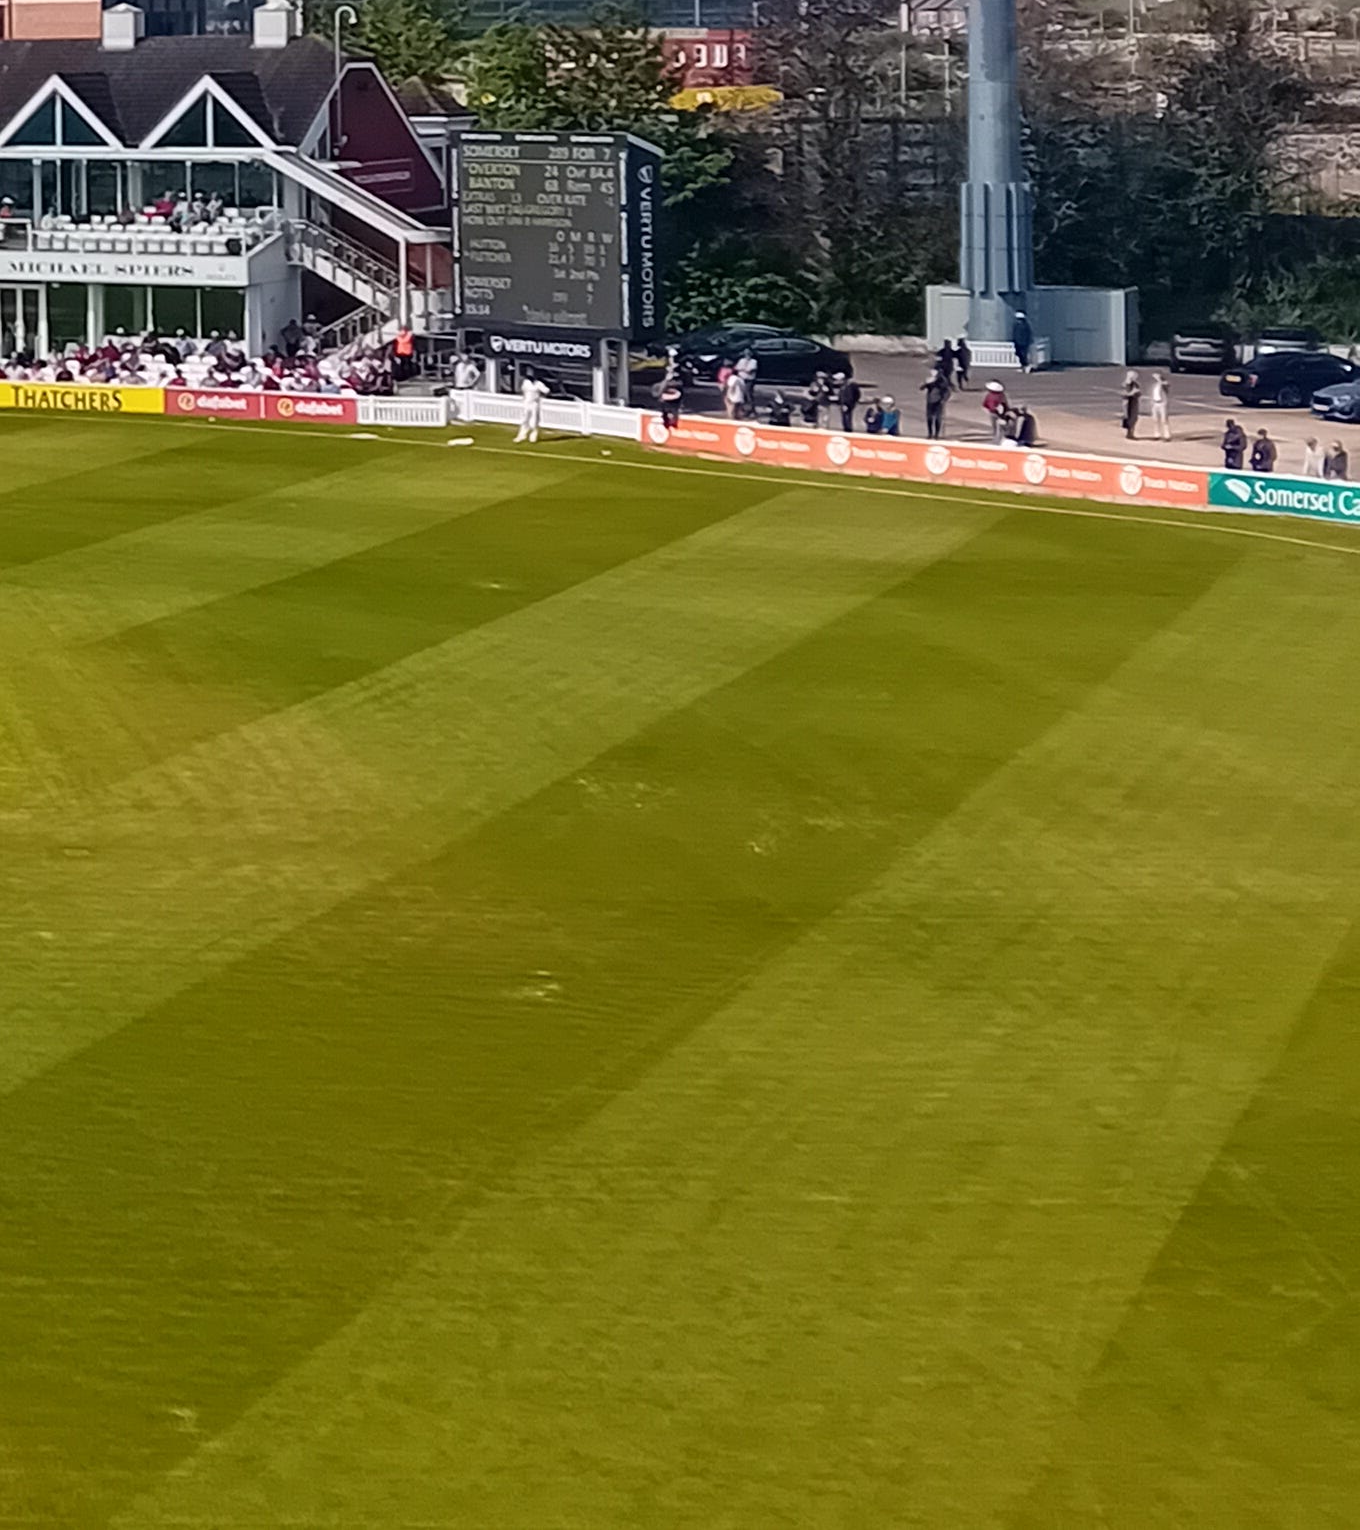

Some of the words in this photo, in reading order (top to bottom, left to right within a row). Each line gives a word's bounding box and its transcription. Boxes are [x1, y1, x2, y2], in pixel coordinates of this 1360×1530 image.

[462, 145, 520, 158] SOMERSET
[572, 147, 596, 159] FOR
[640, 187, 653, 249] VERTU
[8, 261, 110, 277] MICHAEL
[114, 264, 195, 278] SPIERS
[641, 252, 655, 328] MOTORS
[504, 338, 542, 353] VERTU
[543, 342, 592, 358] MOTORS
[11, 385, 122, 411] THATCHERS
[196, 395, 248, 410] dafabet
[295, 400, 344, 416] dafabet
[1253, 480, 1335, 513] Somerset
